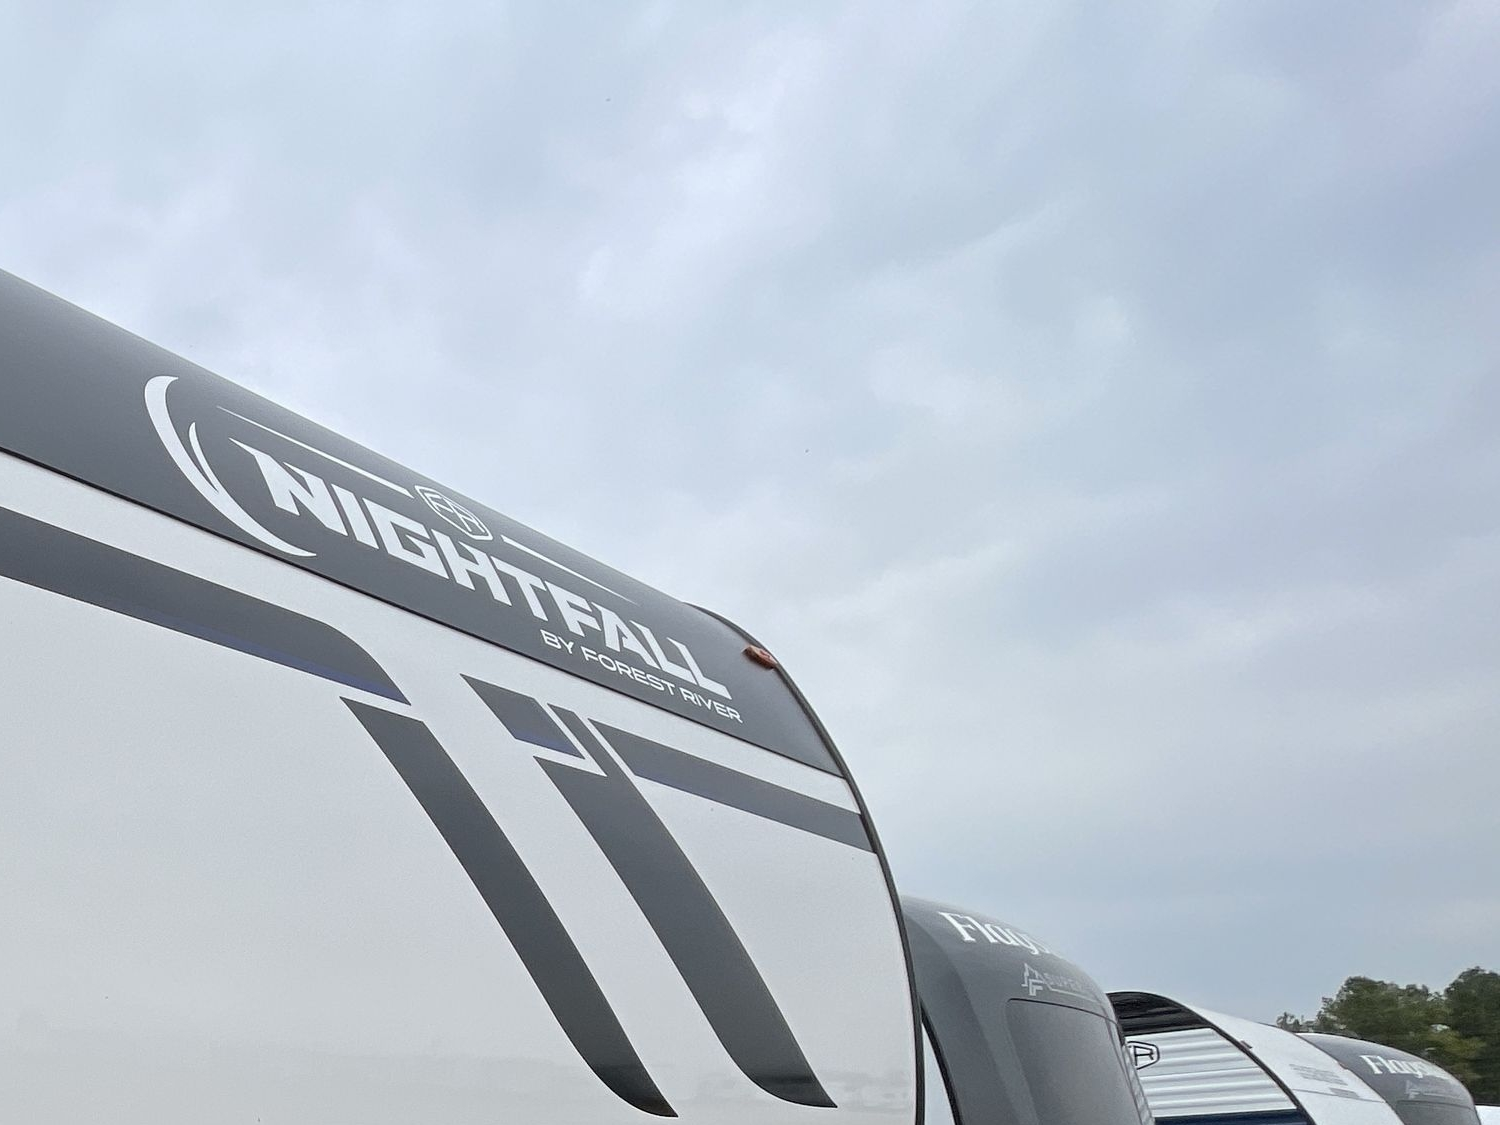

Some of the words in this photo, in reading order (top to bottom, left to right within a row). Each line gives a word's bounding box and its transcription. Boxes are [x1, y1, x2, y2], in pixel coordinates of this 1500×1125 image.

[229, 437, 732, 700] NIGHTFALL
[539, 628, 575, 655] BY
[580, 645, 676, 696] FOREST
[678, 687, 744, 724] RIVER
